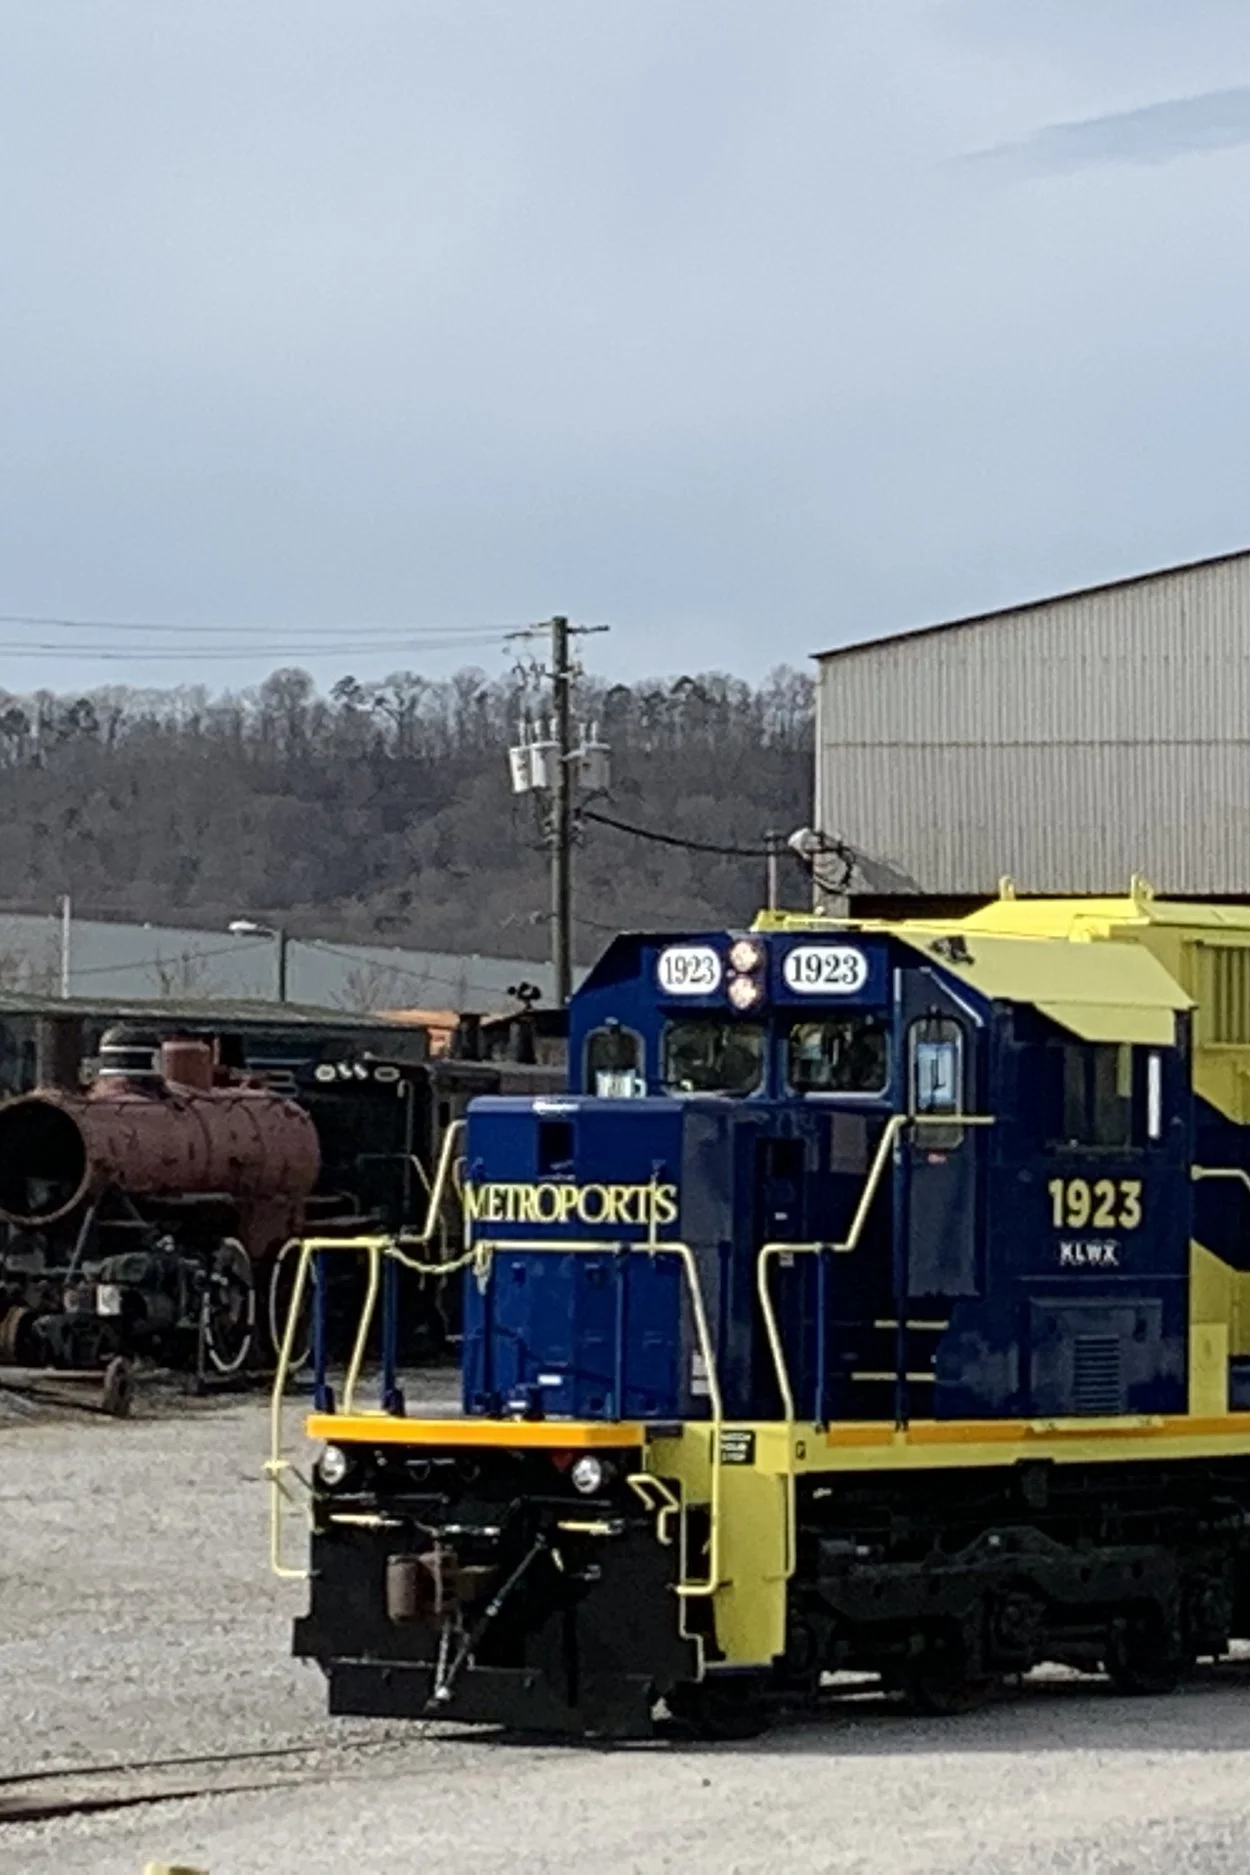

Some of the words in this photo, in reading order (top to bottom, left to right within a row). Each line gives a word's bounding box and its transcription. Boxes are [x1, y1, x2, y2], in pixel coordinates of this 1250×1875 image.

[664, 955, 716, 985] 1923
[791, 954, 859, 984] 1923
[464, 1183, 678, 1224] METROPORTS
[1048, 1178, 1142, 1229] 1923
[1060, 1240, 1119, 1266] KLWX
